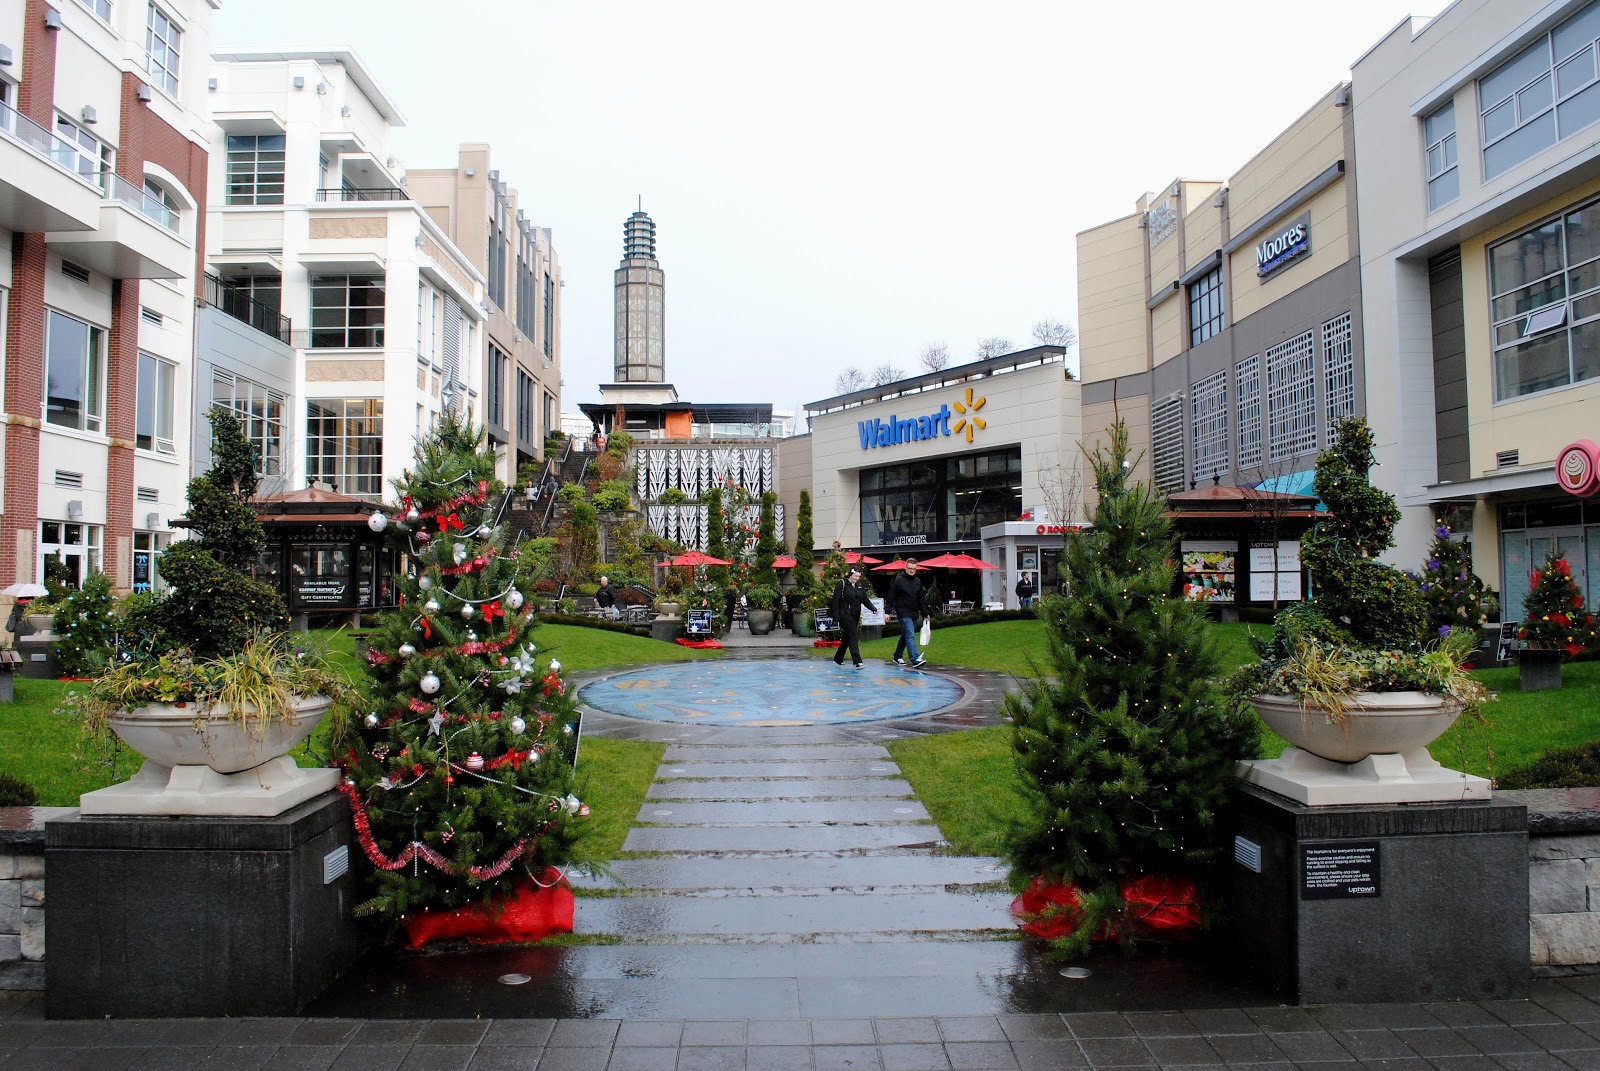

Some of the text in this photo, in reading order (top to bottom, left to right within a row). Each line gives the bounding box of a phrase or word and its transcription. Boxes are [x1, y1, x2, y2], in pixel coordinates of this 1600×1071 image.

[1255, 224, 1306, 267] Moores
[857, 404, 951, 450] Walmart
[1047, 525, 1083, 534] ROGR
